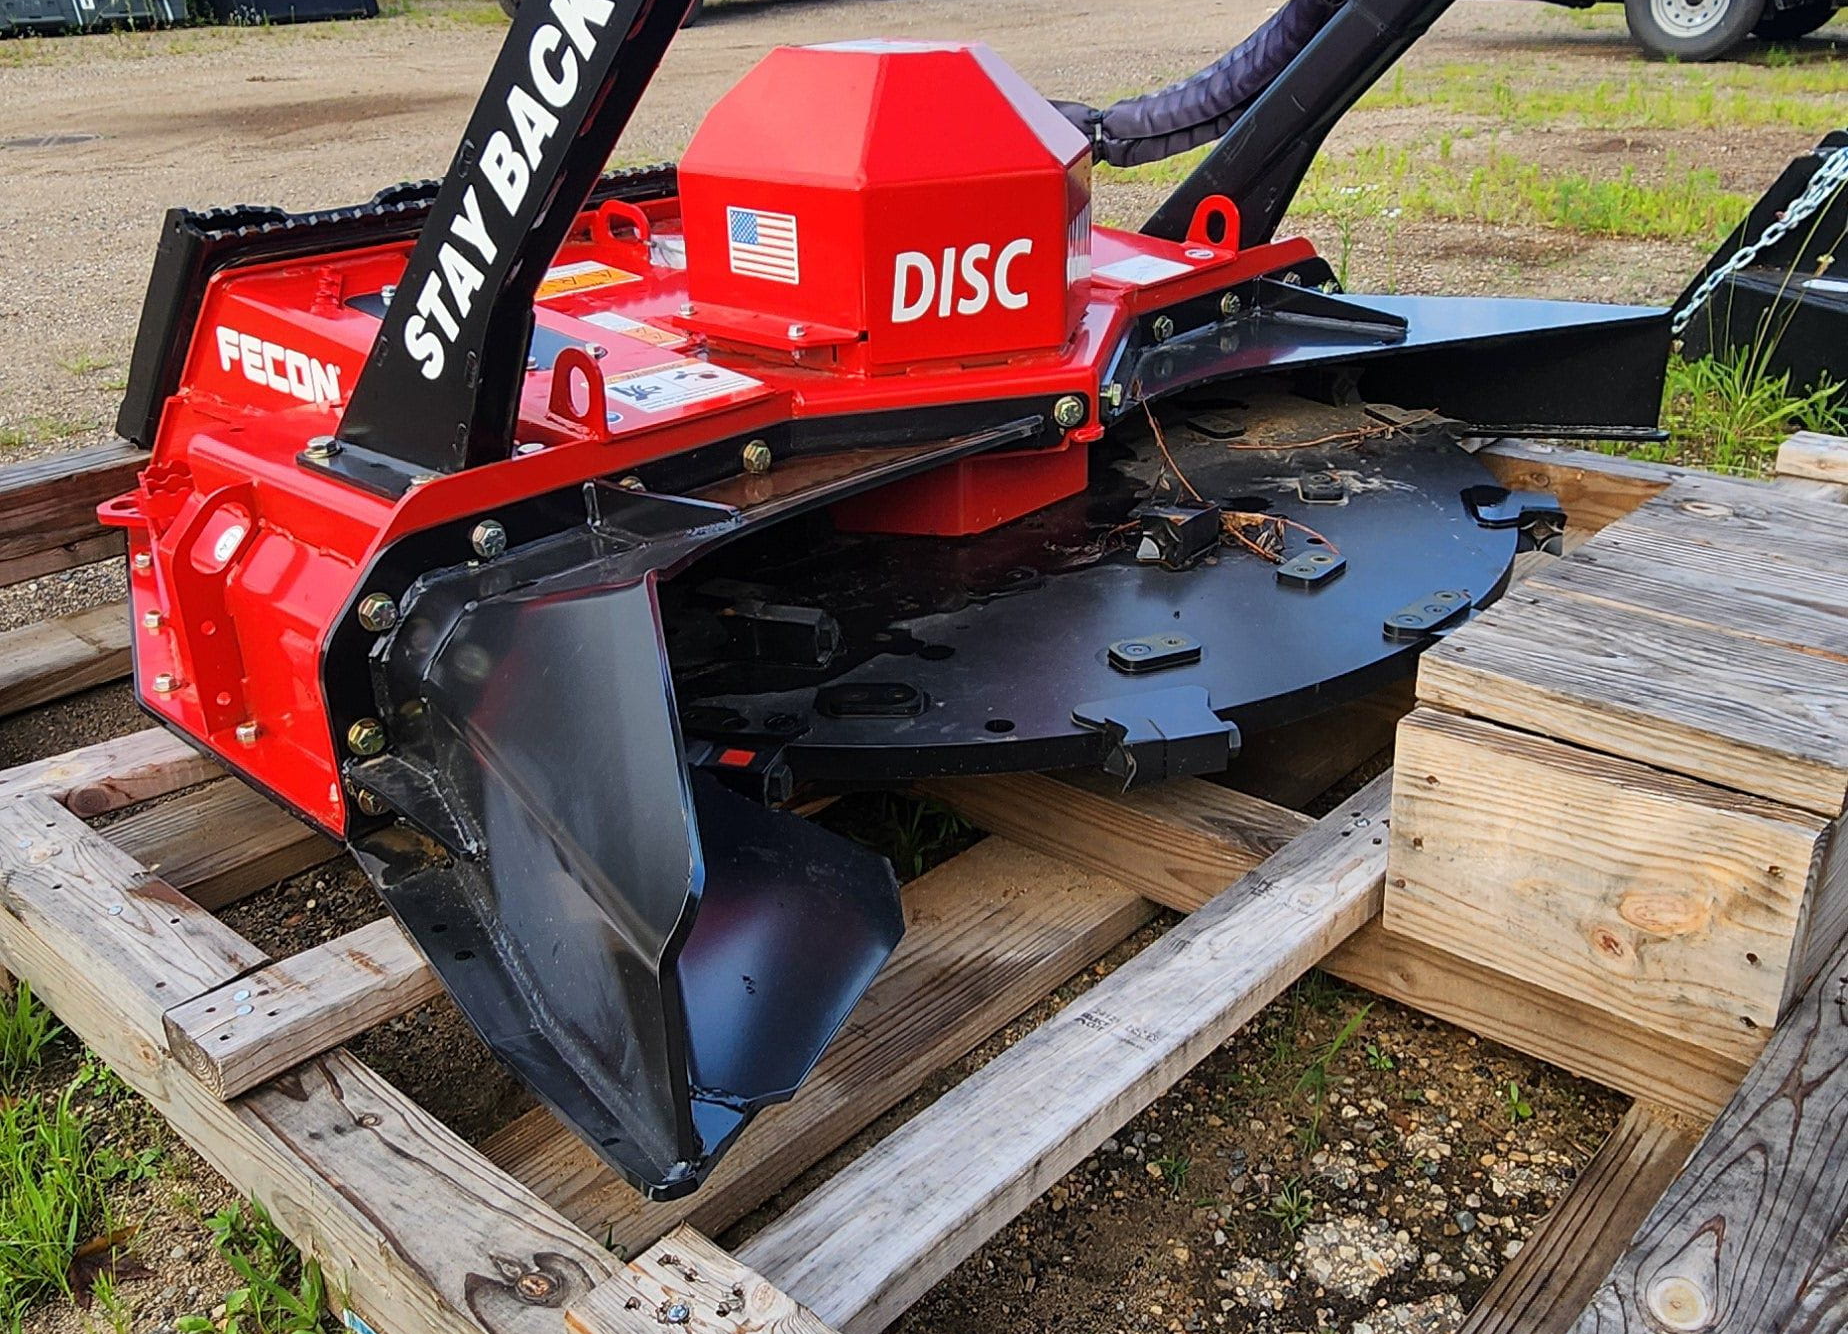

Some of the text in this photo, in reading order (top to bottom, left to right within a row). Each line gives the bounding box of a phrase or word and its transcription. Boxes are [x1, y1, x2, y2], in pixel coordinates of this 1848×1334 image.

[404, 185, 498, 380] STAY
[891, 238, 1033, 323] DISC
[216, 326, 341, 404] FECON
